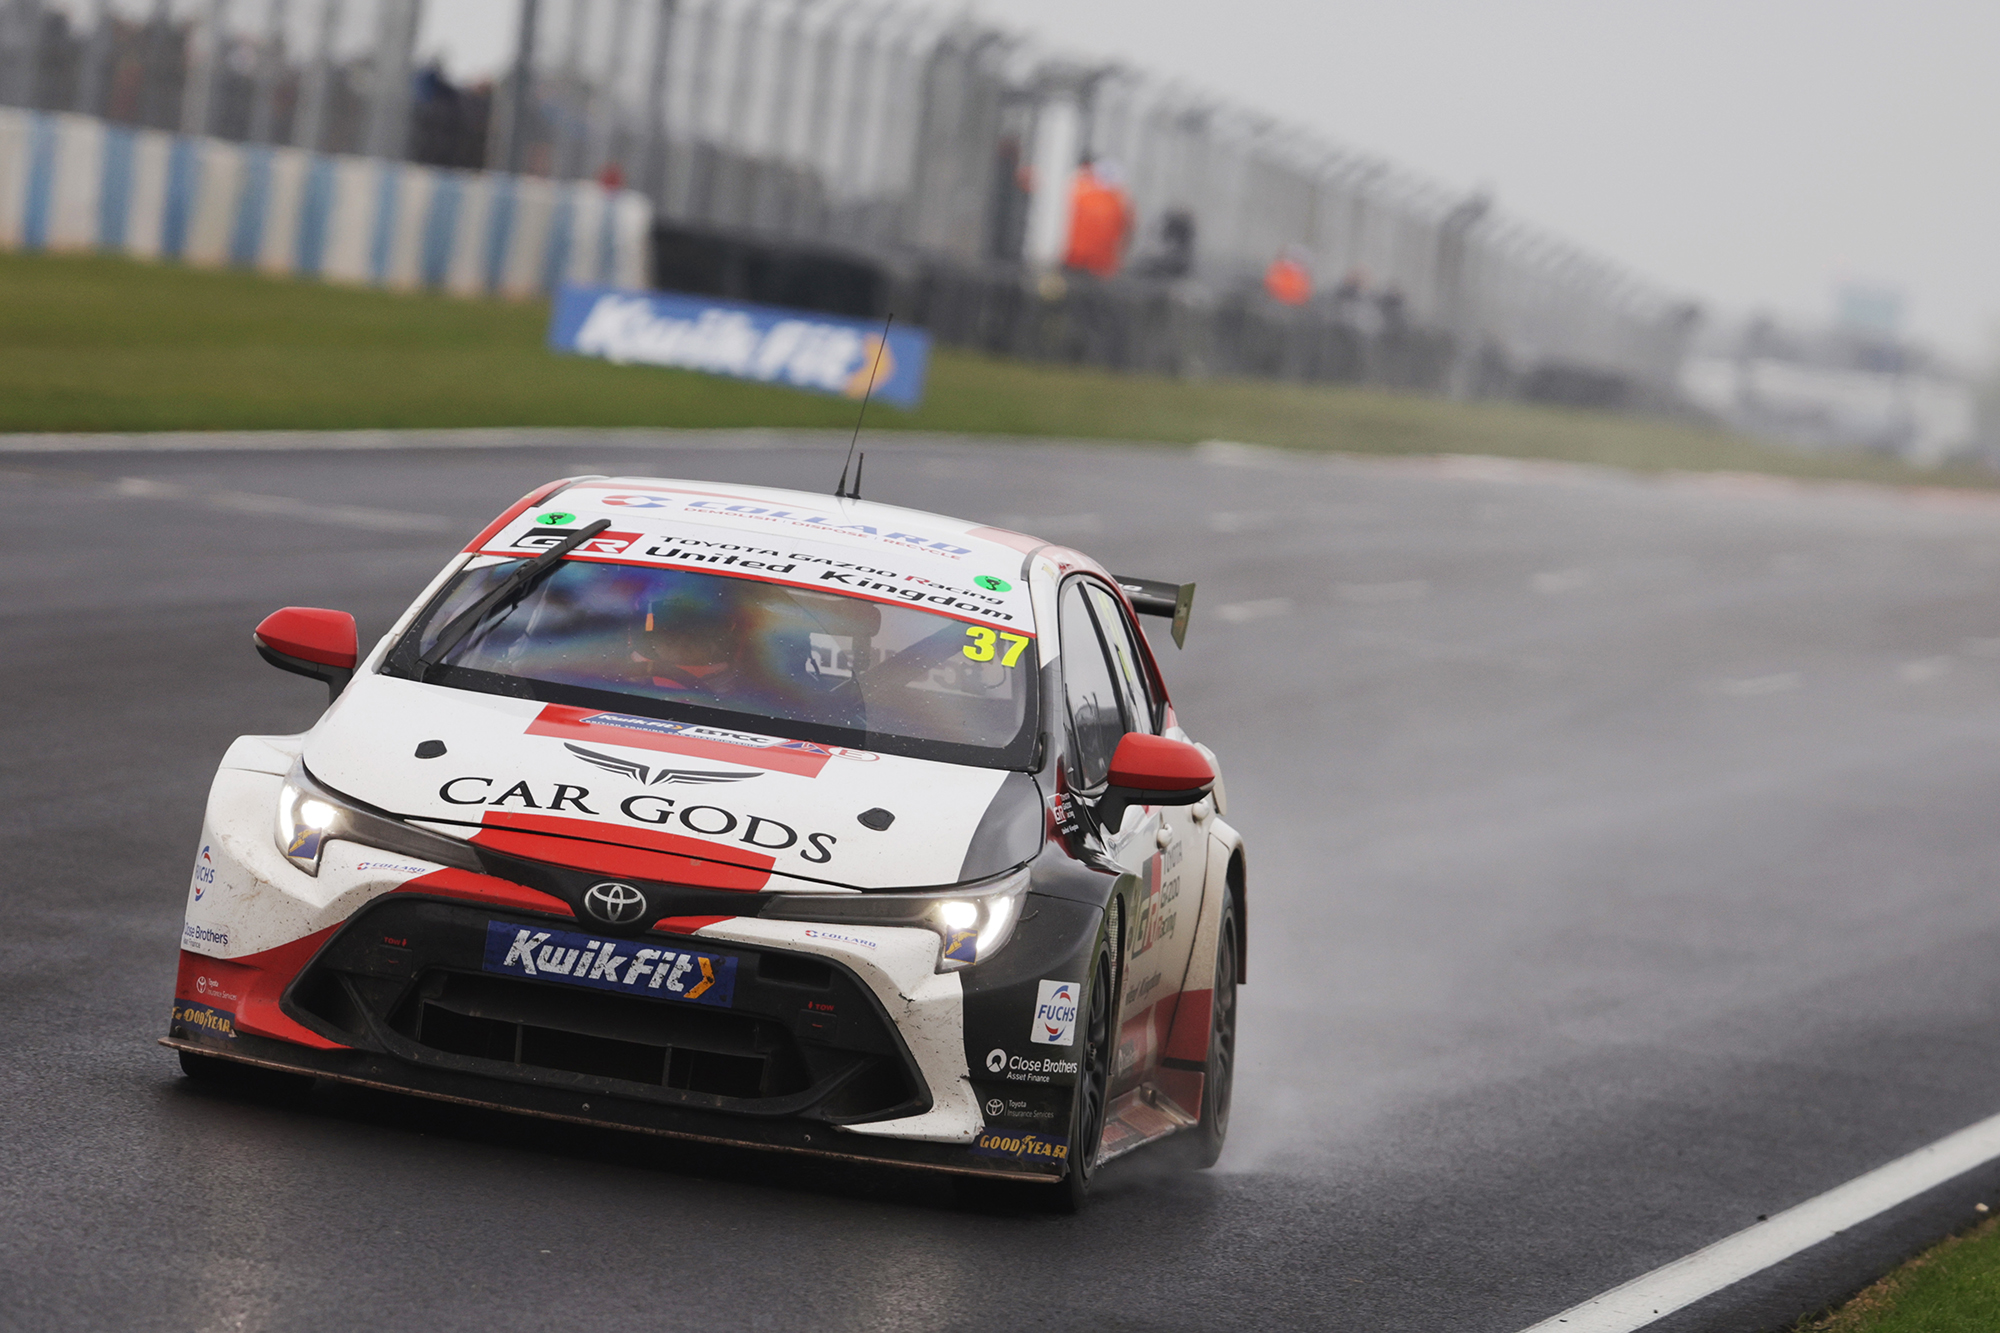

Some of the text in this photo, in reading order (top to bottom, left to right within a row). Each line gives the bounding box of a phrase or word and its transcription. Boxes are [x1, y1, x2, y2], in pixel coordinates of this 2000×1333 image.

[684, 506, 961, 560] DEMOLISH DISPOSE RECYCLE
[687, 500, 972, 555] COLLARD
[660, 535, 779, 556] TOYOTA
[788, 552, 897, 577] GAZOO
[903, 575, 1005, 605] Racing
[645, 546, 1014, 622] United Kingdom
[962, 625, 1030, 668] 37
[693, 726, 771, 744] BTCC
[438, 776, 838, 864] CAR GODS
[195, 925, 229, 945] Brothers
[384, 936, 401, 946] TOW
[815, 1003, 835, 1011] TOW
[1037, 1004, 1076, 1023] FUCHS
[1009, 1055, 1079, 1074] Close Brothers
[1006, 1071, 1051, 1083] Asset Finance
[1008, 1099, 1028, 1109] Toyota
[1007, 1109, 1055, 1119] Insurance Services
[979, 1134, 1068, 1159] GOODYEAR
